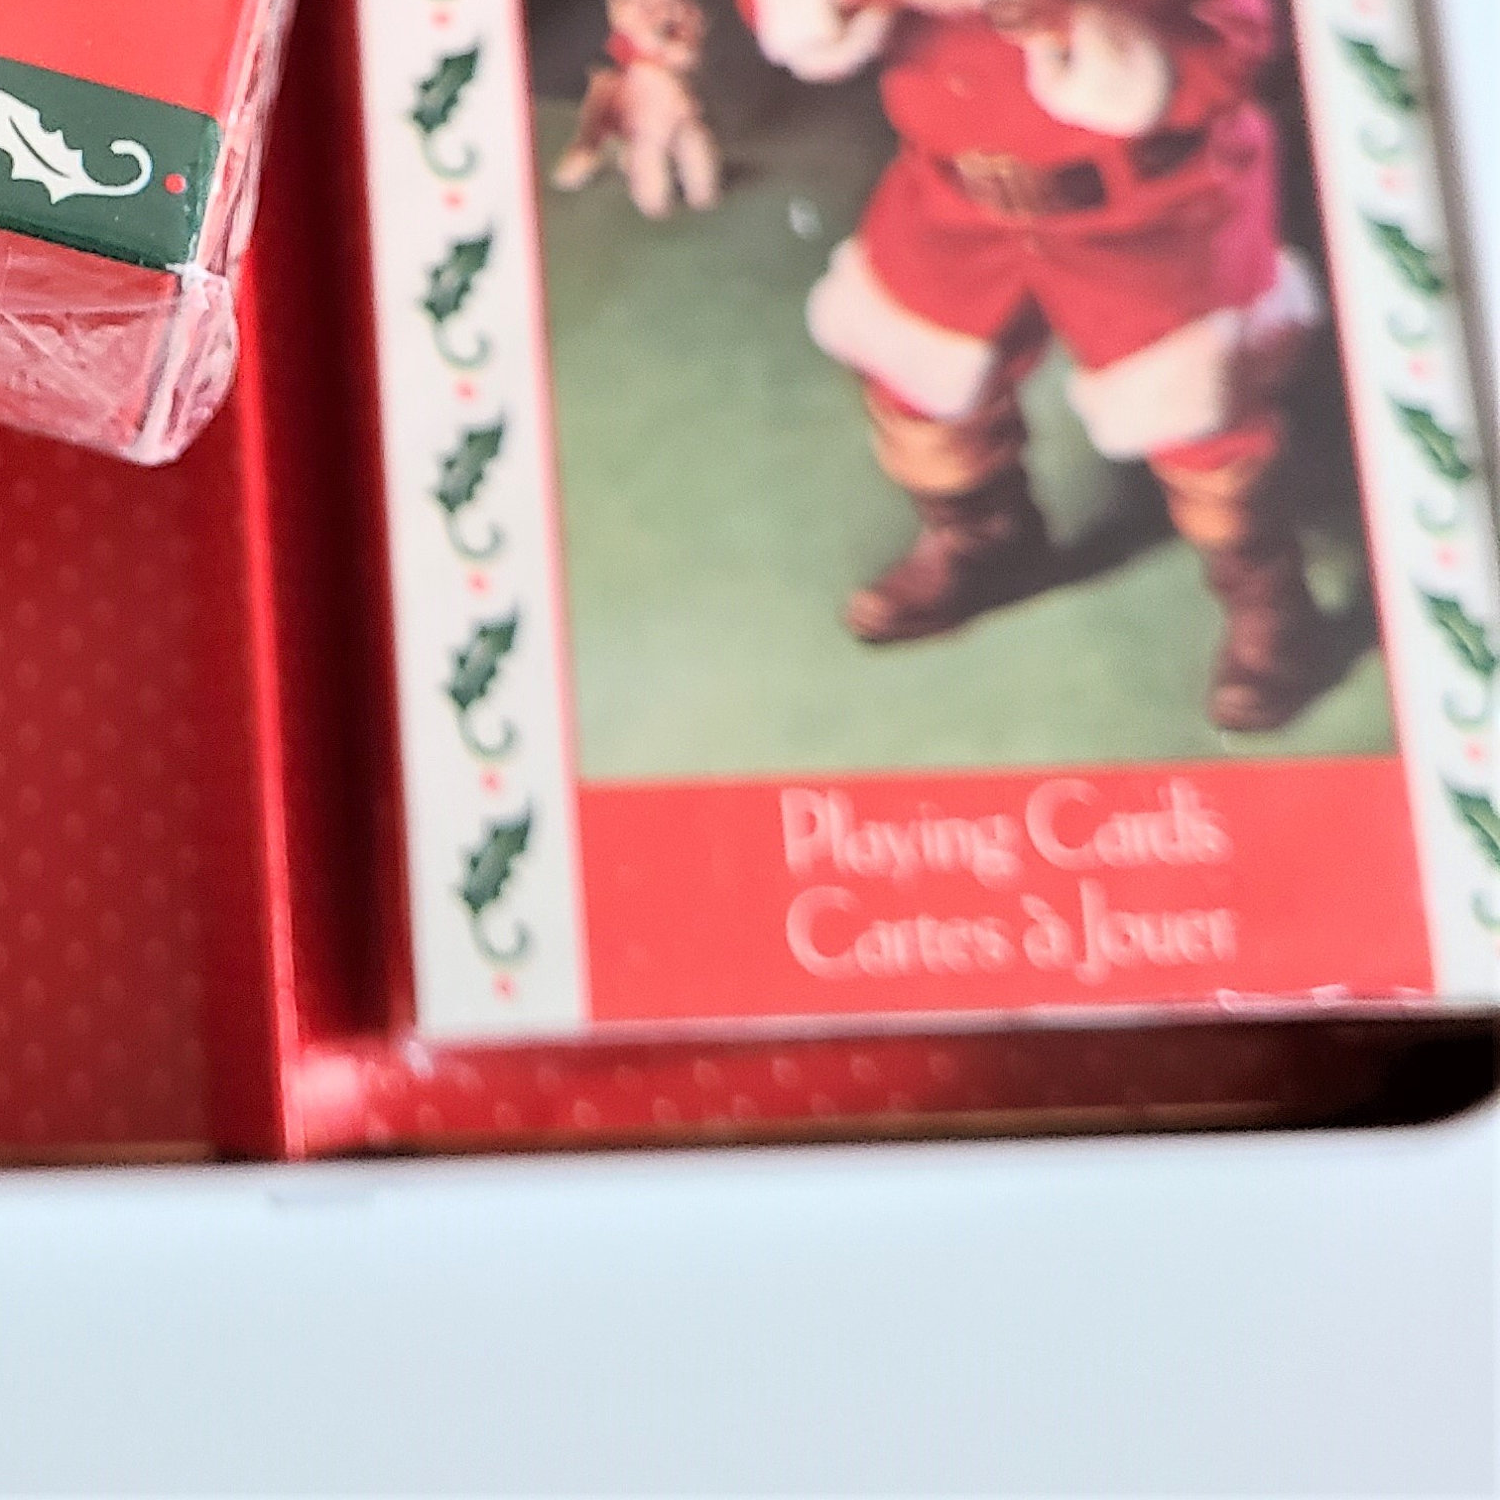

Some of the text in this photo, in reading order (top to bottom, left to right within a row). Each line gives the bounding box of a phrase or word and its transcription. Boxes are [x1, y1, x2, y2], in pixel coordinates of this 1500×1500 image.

[779, 776, 1232, 890] Playing Cards
[785, 876, 1237, 985] Cartes à Jouer
